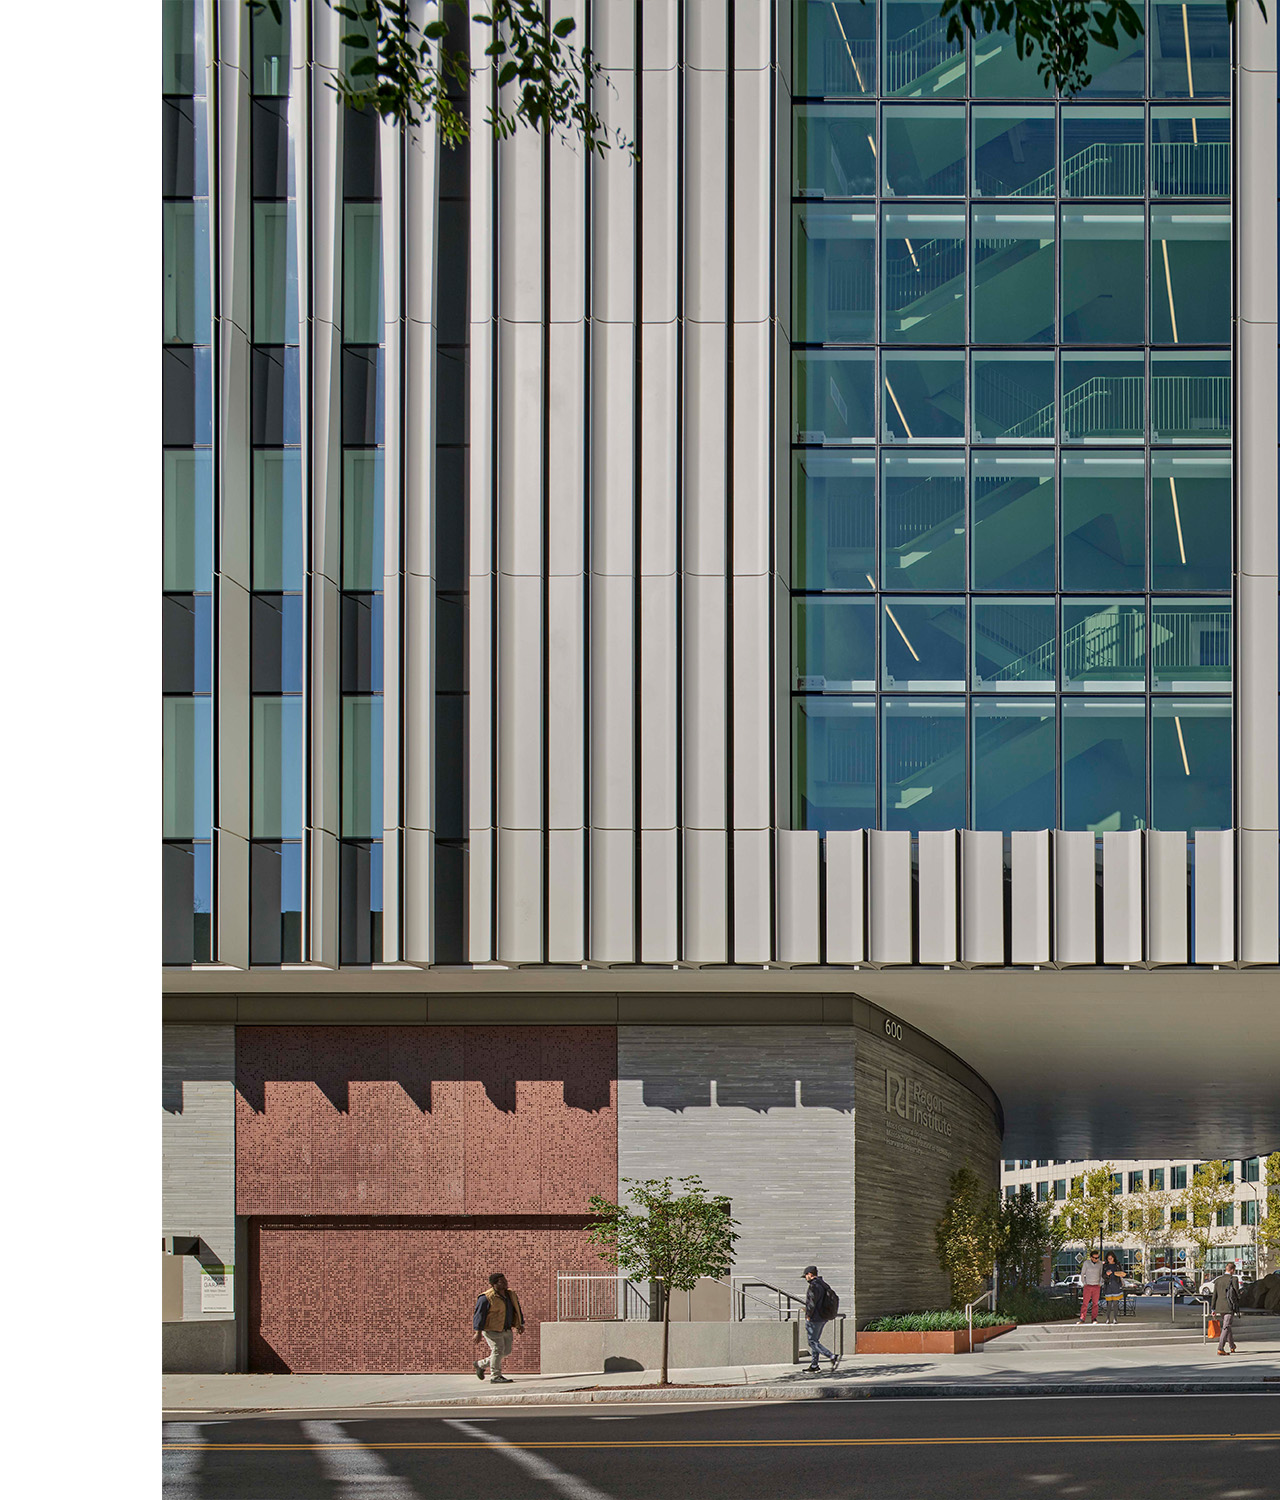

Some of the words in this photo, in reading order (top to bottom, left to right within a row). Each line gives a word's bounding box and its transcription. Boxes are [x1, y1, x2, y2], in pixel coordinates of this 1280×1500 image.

[886, 1019, 902, 1041] 600
[913, 1081, 943, 1113] Ragon
[913, 1104, 951, 1137] Institute
